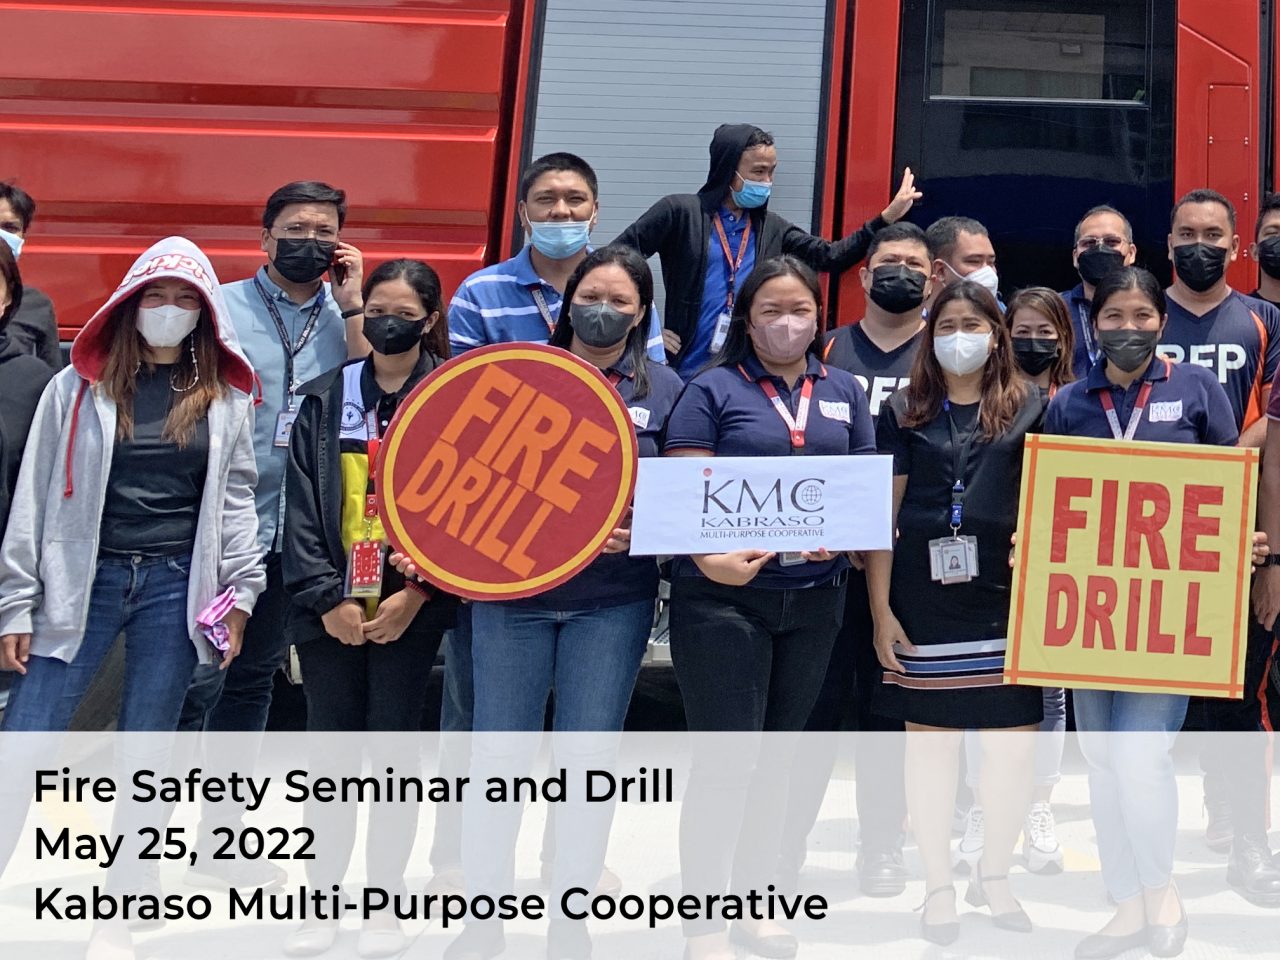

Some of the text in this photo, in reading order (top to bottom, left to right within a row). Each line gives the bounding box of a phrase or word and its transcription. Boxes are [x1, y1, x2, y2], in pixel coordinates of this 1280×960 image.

[439, 362, 618, 514] FIRE
[396, 439, 554, 579] DRILL
[700, 528, 825, 539] MULTI-PURPOSE COOPERATIVE
[701, 515, 825, 527] KABRASO
[702, 474, 826, 514] KMC
[1050, 476, 1224, 573] FIRE
[1043, 572, 1213, 656] DRILL
